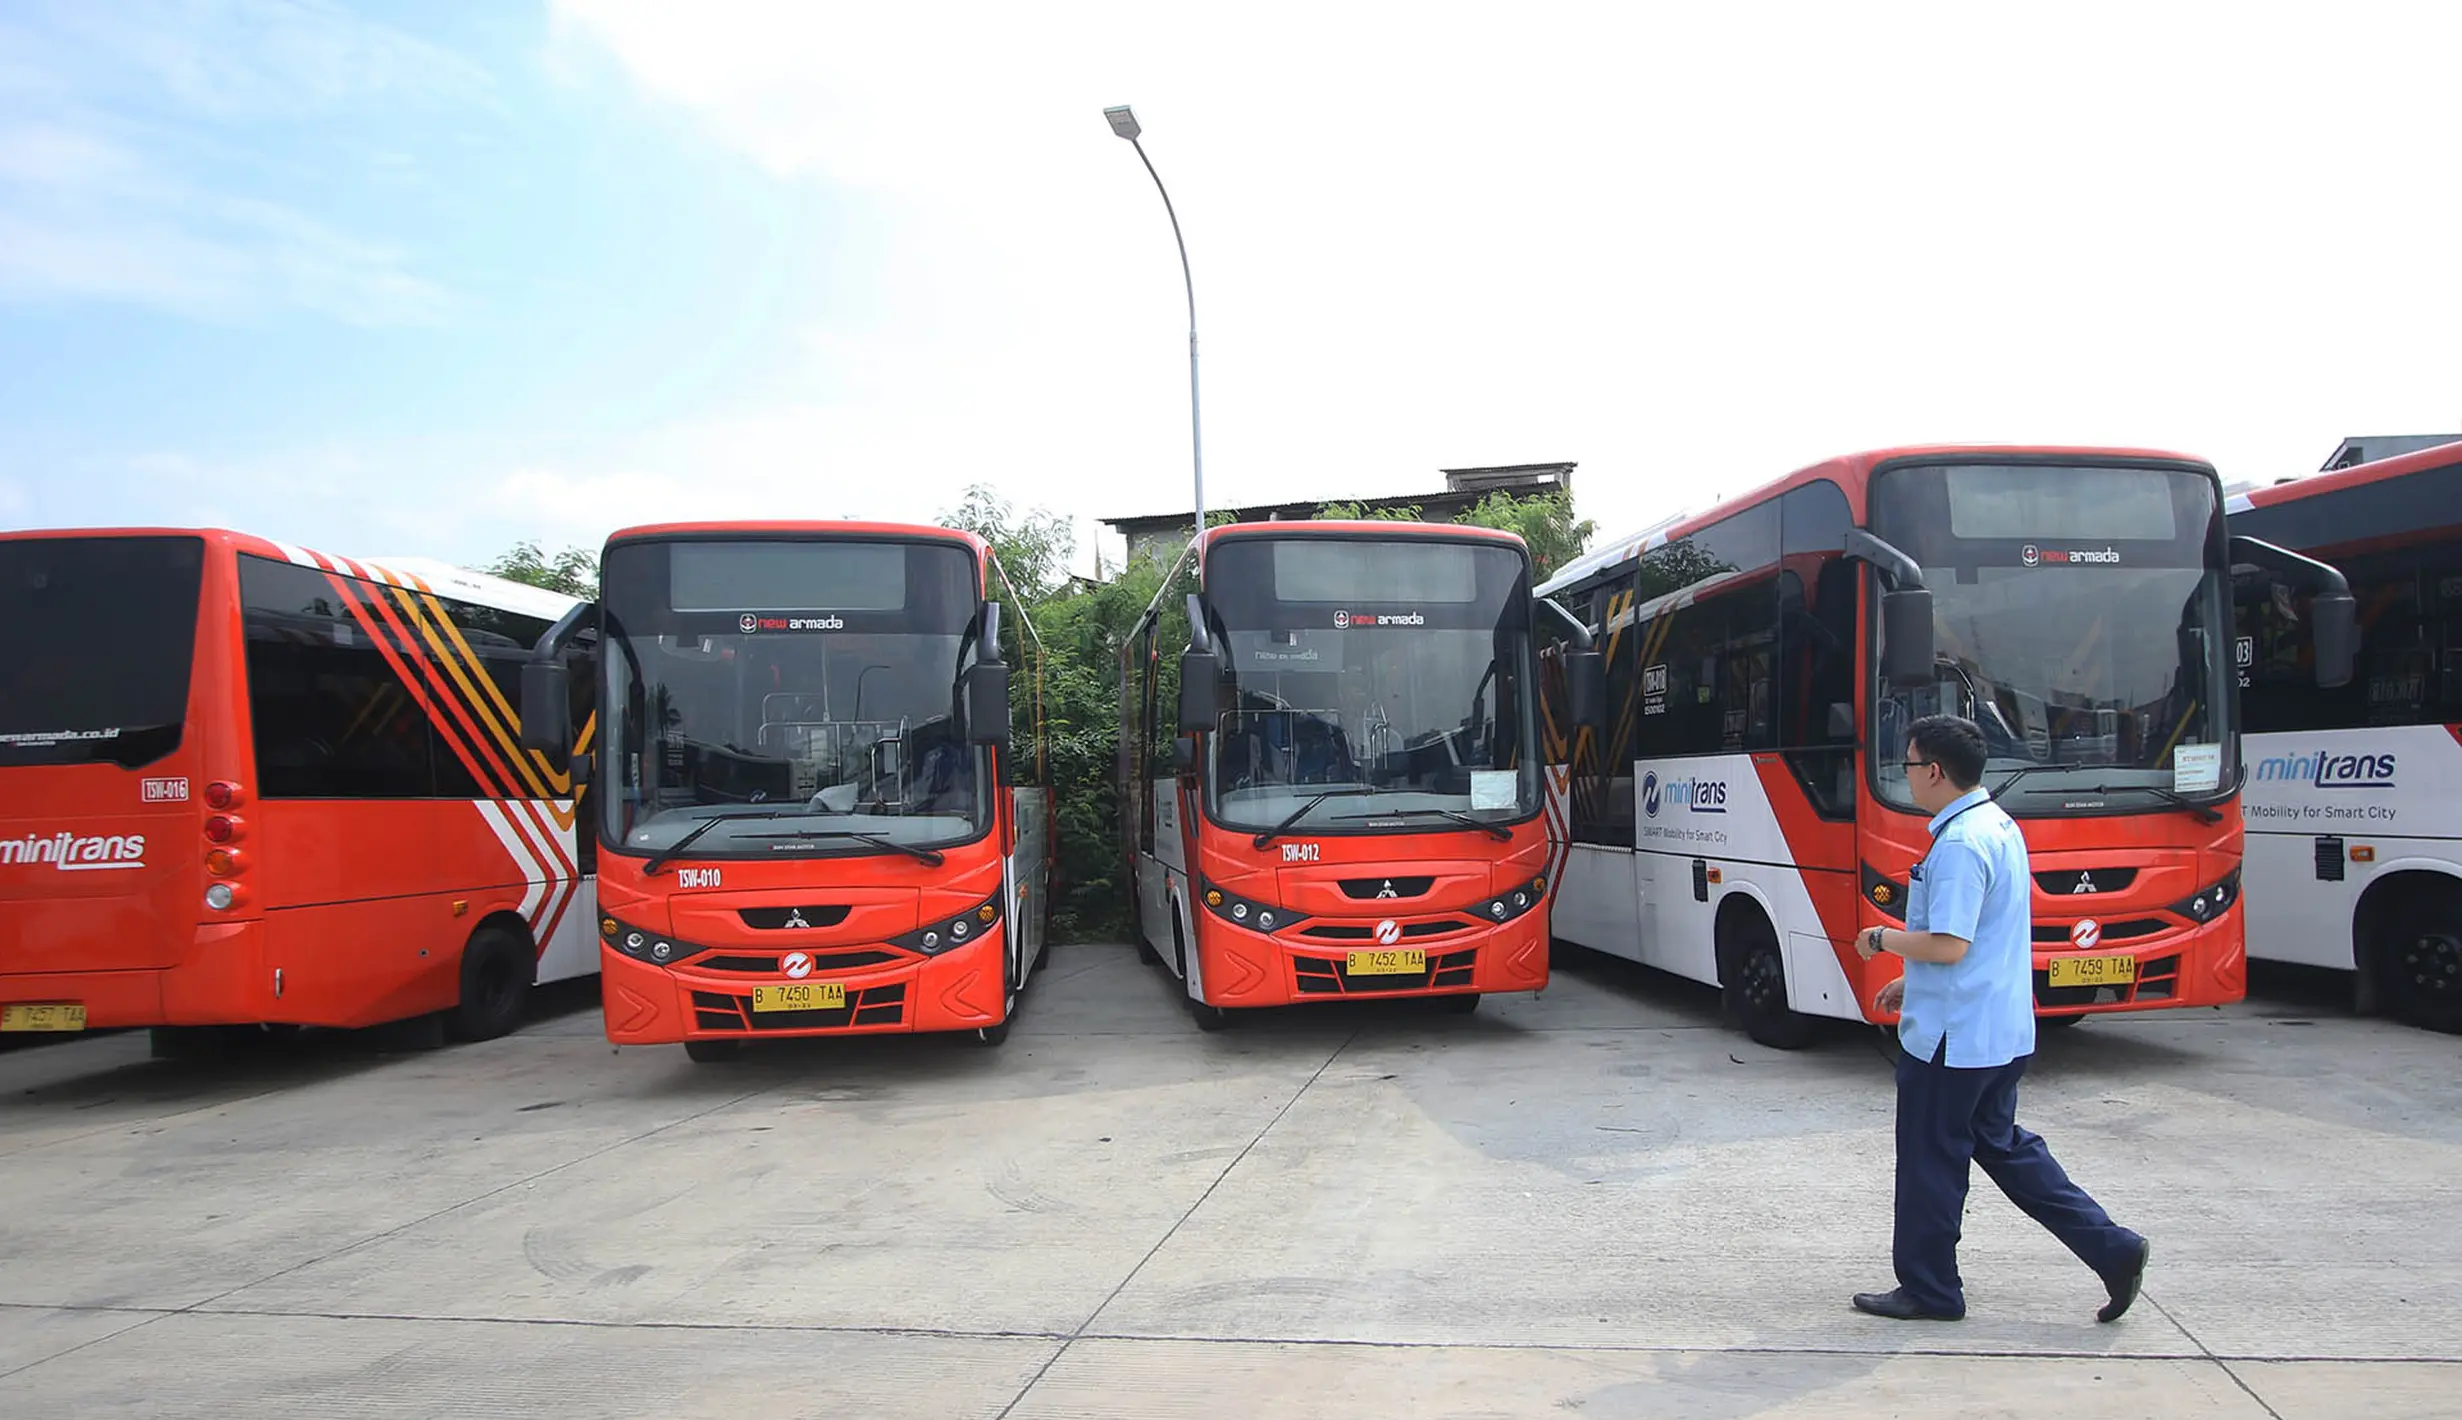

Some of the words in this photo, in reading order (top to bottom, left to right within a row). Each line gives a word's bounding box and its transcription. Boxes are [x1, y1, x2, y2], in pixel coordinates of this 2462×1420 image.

[2041, 551, 2068, 563] new
[2069, 546, 2120, 563] armada
[758, 619, 787, 629] new
[789, 615, 843, 629] armada
[1377, 612, 1424, 625] armada
[2256, 750, 2395, 788] minitrans
[145, 781, 188, 799] TSW-016
[1664, 777, 1727, 813] minitrans
[2251, 805, 2300, 820] Mobility
[2303, 805, 2321, 818] for
[2325, 805, 2364, 819] Smart
[2368, 805, 2397, 820] City
[0, 832, 146, 870] minitrans
[1281, 843, 1320, 861] TSW-012
[678, 868, 721, 888] TSW-010
[1349, 954, 1356, 967] B
[1369, 952, 1397, 967] 7452
[1404, 951, 1424, 966] TAA
[2052, 961, 2060, 977] B
[2073, 959, 2103, 976] 7459
[2112, 958, 2132, 975] TAA
[755, 988, 763, 1003] B
[777, 986, 810, 1002] 7450
[819, 985, 842, 1000] TAA
